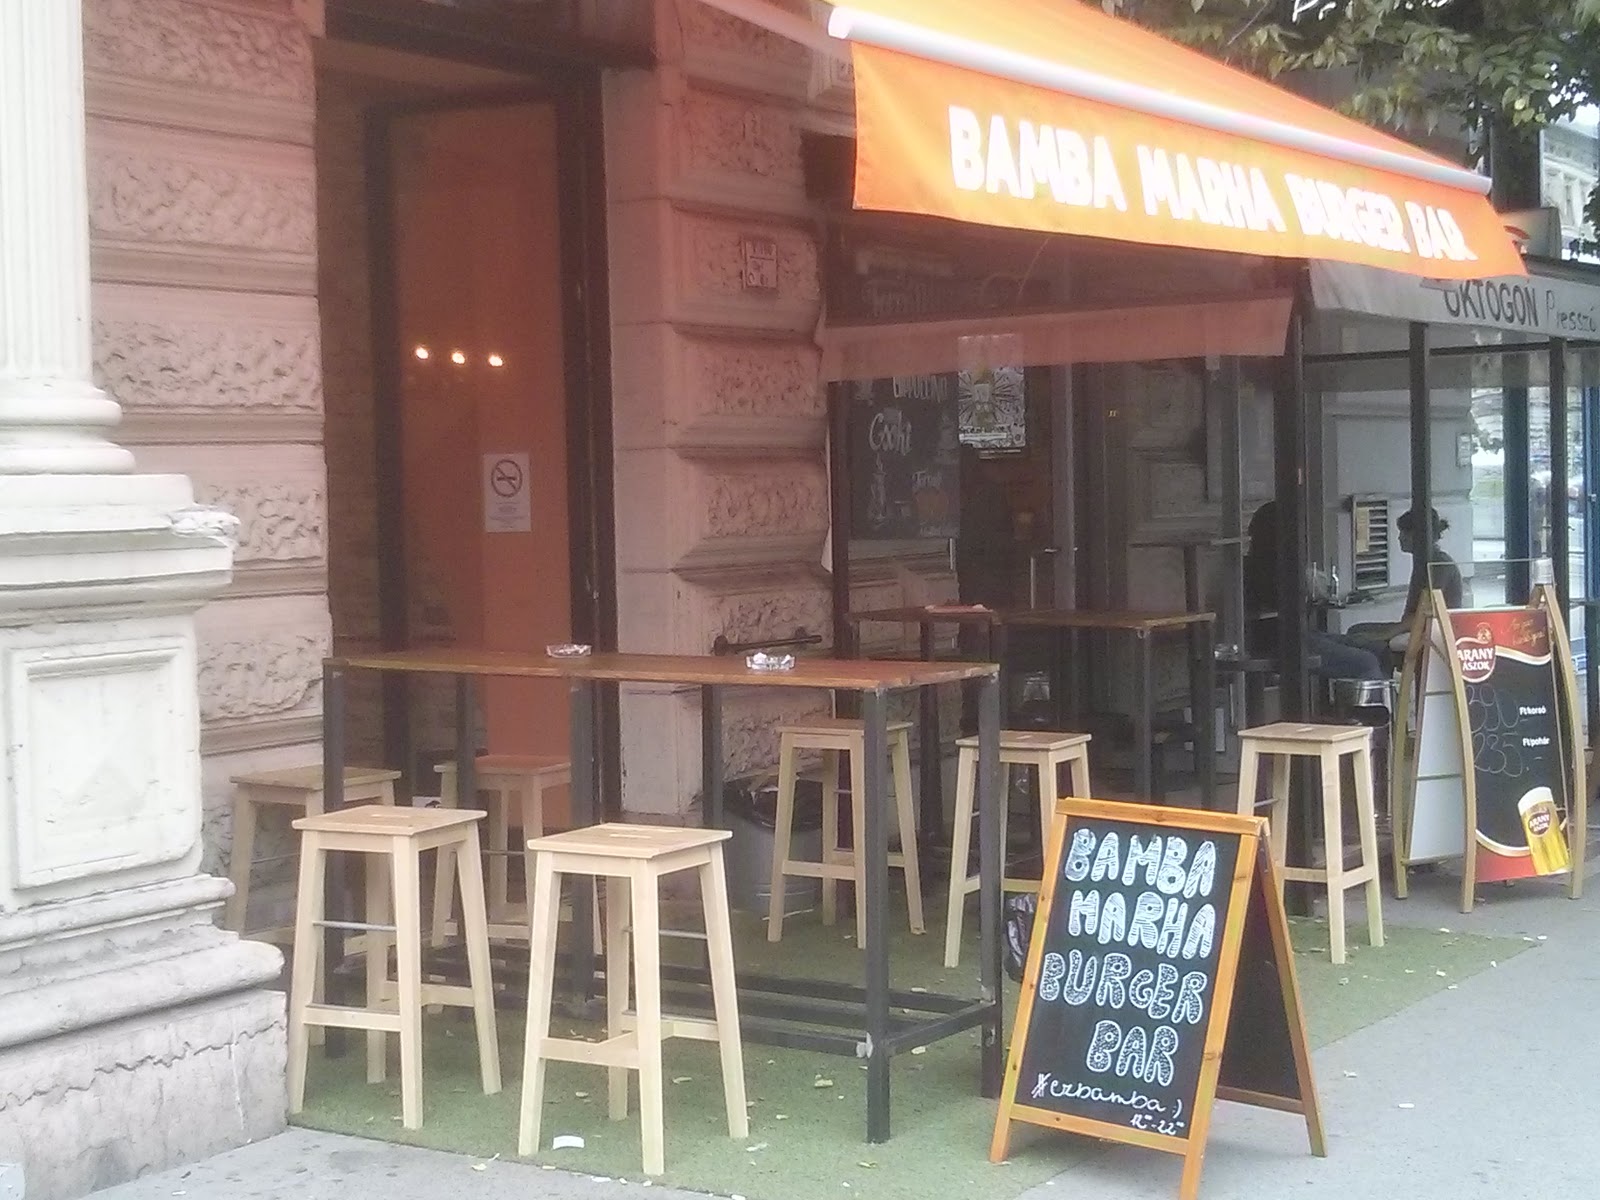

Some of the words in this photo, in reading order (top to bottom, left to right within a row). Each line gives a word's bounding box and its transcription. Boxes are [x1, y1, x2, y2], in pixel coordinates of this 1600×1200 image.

[948, 105, 1127, 212] BAMBA
[1137, 143, 1288, 232] MARHA
[1284, 173, 1410, 253] BURGER
[1405, 201, 1478, 261] BAR
[1444, 279, 1539, 327] OKTOGON
[1457, 648, 1494, 661] ARANY
[1065, 828, 1216, 899] BAMBA
[1068, 889, 1216, 960] MARHA
[1039, 949, 1208, 1025] BURGER
[1085, 1020, 1179, 1087] BAR
